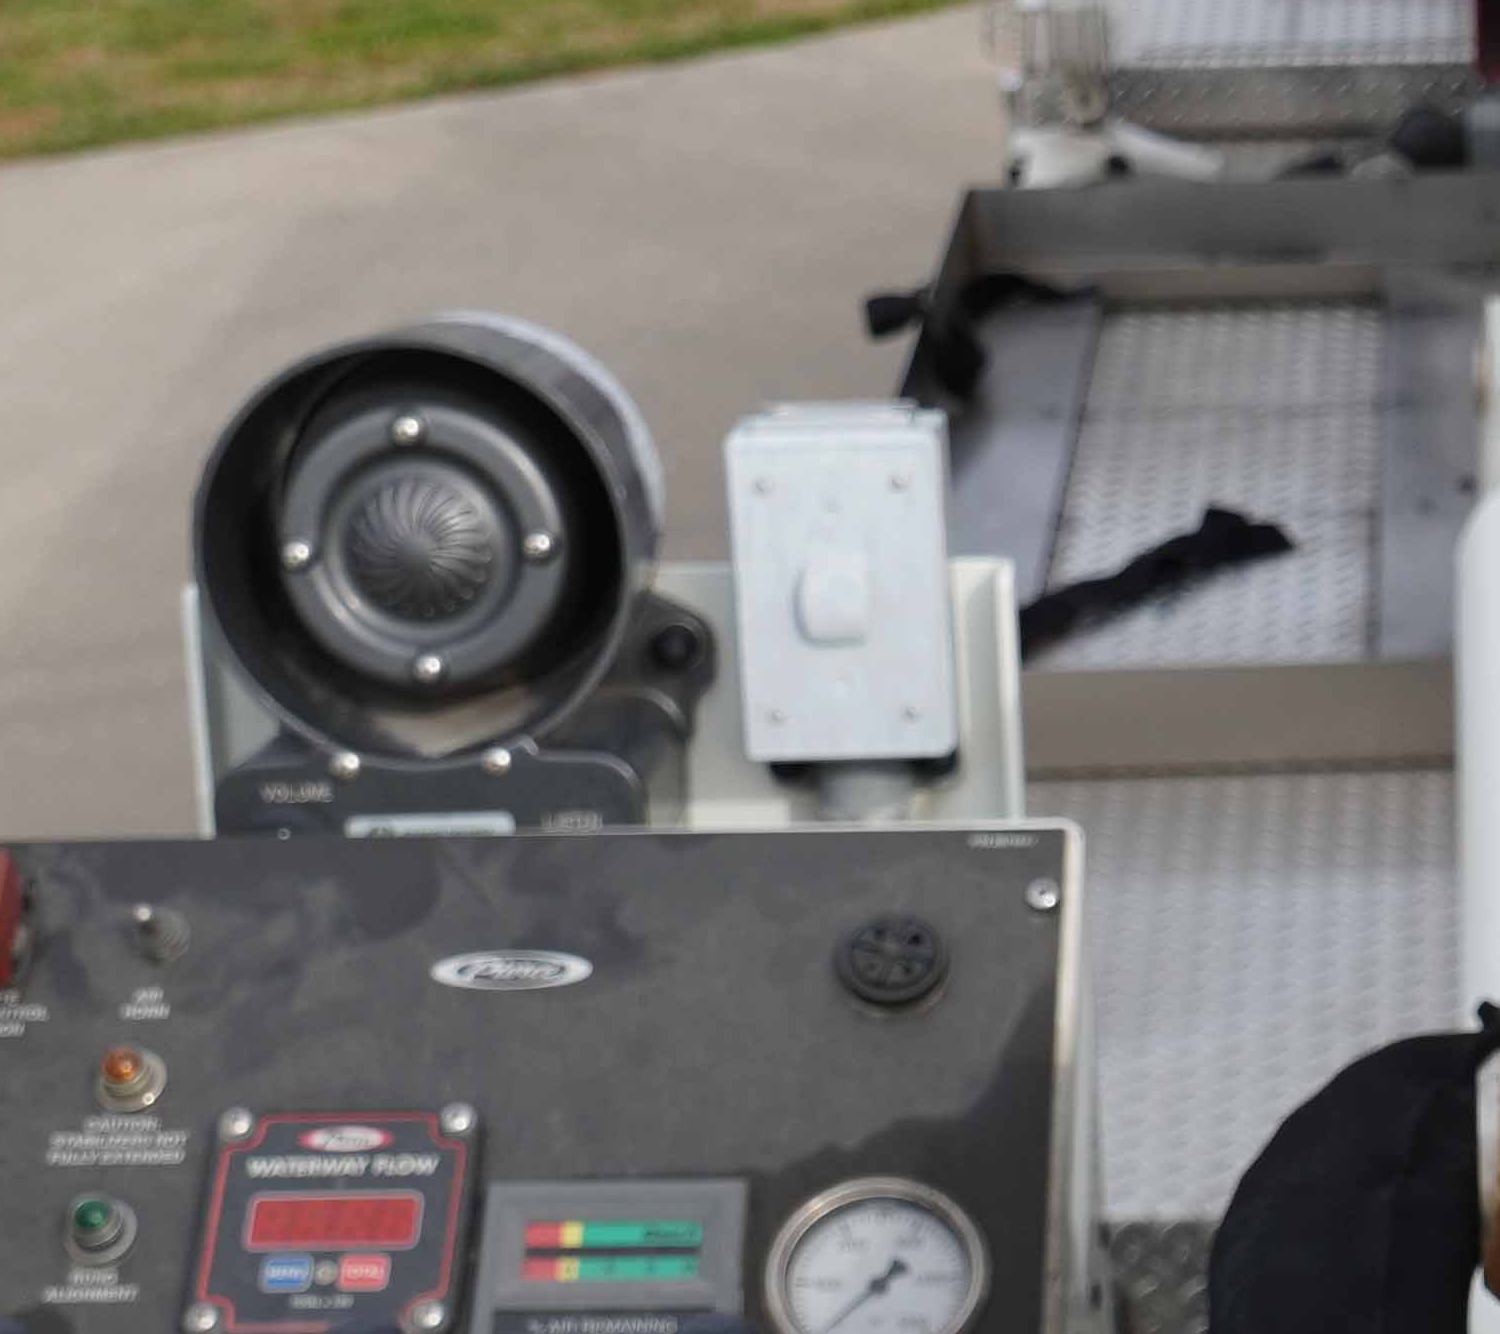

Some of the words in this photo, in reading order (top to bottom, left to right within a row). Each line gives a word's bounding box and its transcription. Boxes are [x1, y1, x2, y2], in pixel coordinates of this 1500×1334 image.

[260, 782, 333, 803] VOLUME
[248, 1155, 369, 1178] WATERWAY
[372, 1154, 441, 1176] FLOW
[43, 1286, 140, 1302] ALIGNMENT
[582, 1318, 678, 1334] REMAINING
